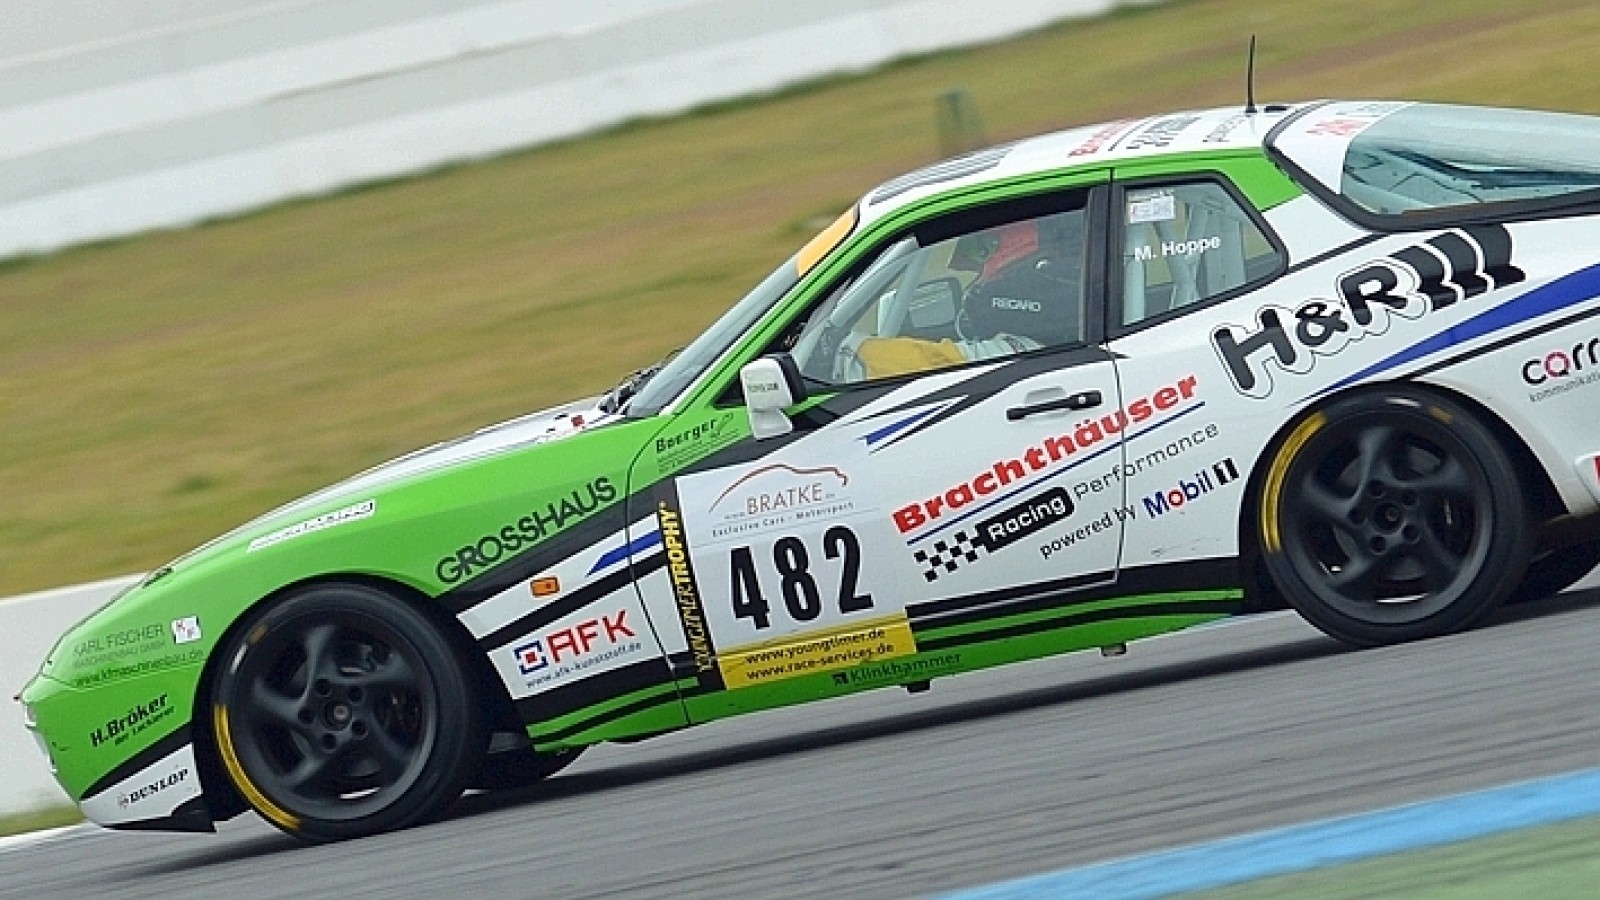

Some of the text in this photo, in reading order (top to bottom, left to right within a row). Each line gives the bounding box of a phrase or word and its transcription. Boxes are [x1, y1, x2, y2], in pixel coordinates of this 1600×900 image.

[1161, 236, 1221, 256] Hoppe
[1212, 262, 1412, 393] H&R
[892, 374, 1197, 535] Brachthäuser
[747, 482, 823, 515] BRATKE
[987, 495, 1066, 543] Racing
[1039, 511, 1114, 560] powered
[1117, 503, 1138, 523] by
[1142, 470, 1214, 519] Mobil
[435, 476, 617, 584] GROSSHAUS
[730, 525, 875, 630] 482
[105, 624, 165, 648] FISCHER
[545, 609, 636, 663] AFK
[745, 628, 886, 664] www.youngtimer.de
[746, 643, 895, 680] www.race-services.de
[850, 654, 962, 681] Klinkhammer
[129, 768, 188, 804] DUNLOP
